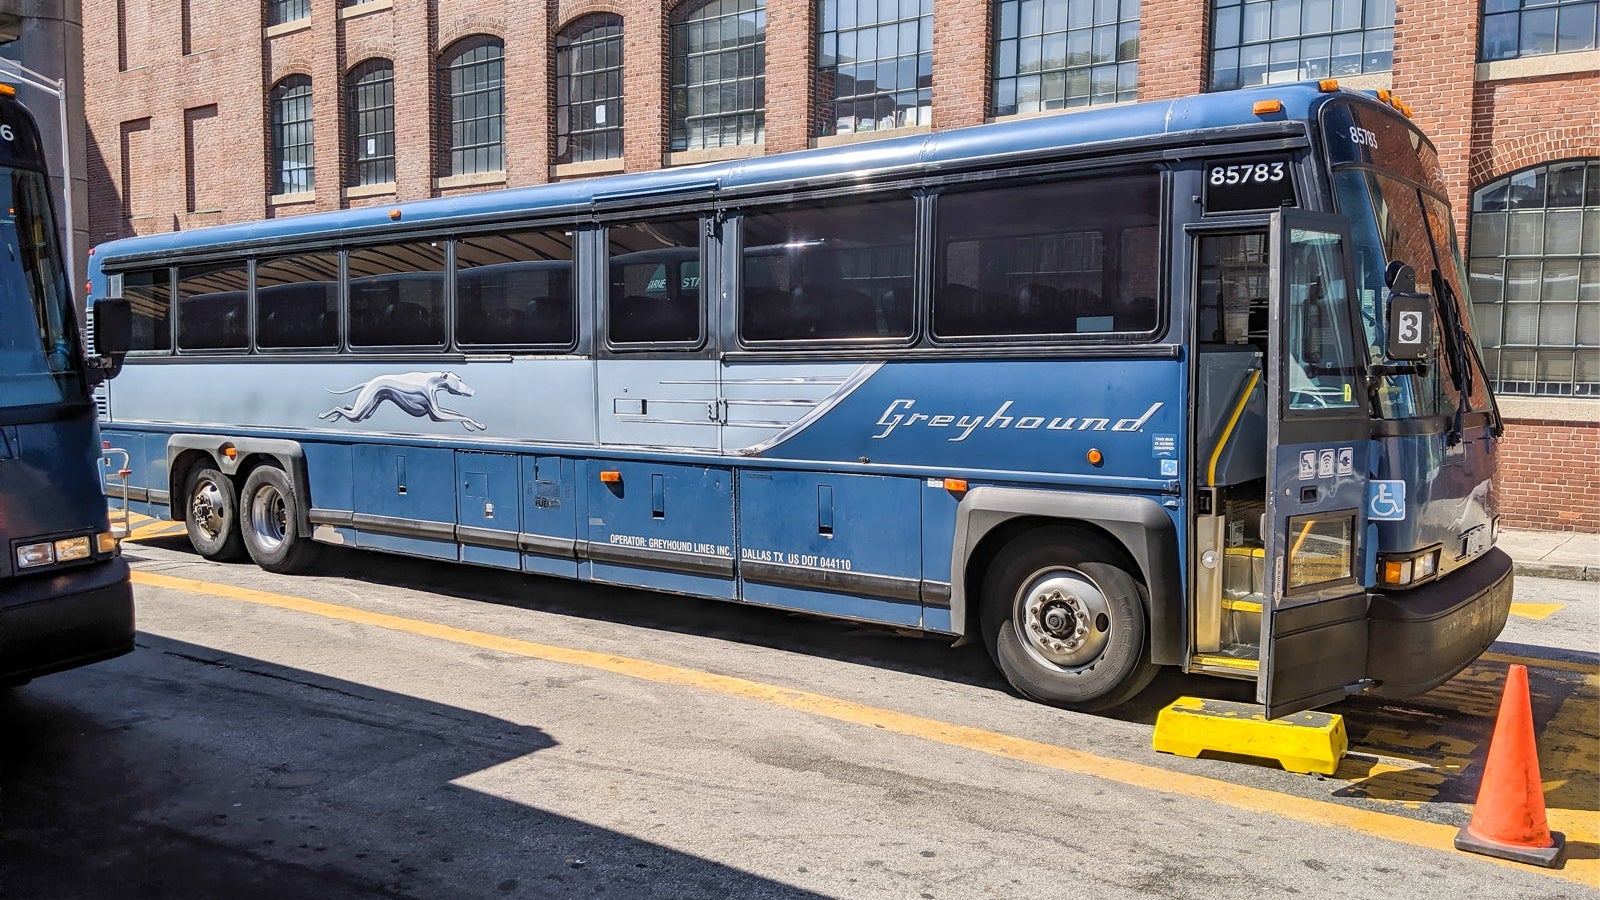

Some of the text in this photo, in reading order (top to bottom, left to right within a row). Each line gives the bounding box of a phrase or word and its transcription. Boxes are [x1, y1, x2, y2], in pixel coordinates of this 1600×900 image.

[0, 124, 14, 141] 6
[1349, 126, 1378, 149] 85783
[1210, 162, 1285, 185] 85783
[1400, 313, 1419, 342] 3
[872, 398, 1164, 442] Greyhound
[610, 533, 851, 570] OPERATOR: GREYHOUND LINES INC. DALLAS TX US DOT 044110
